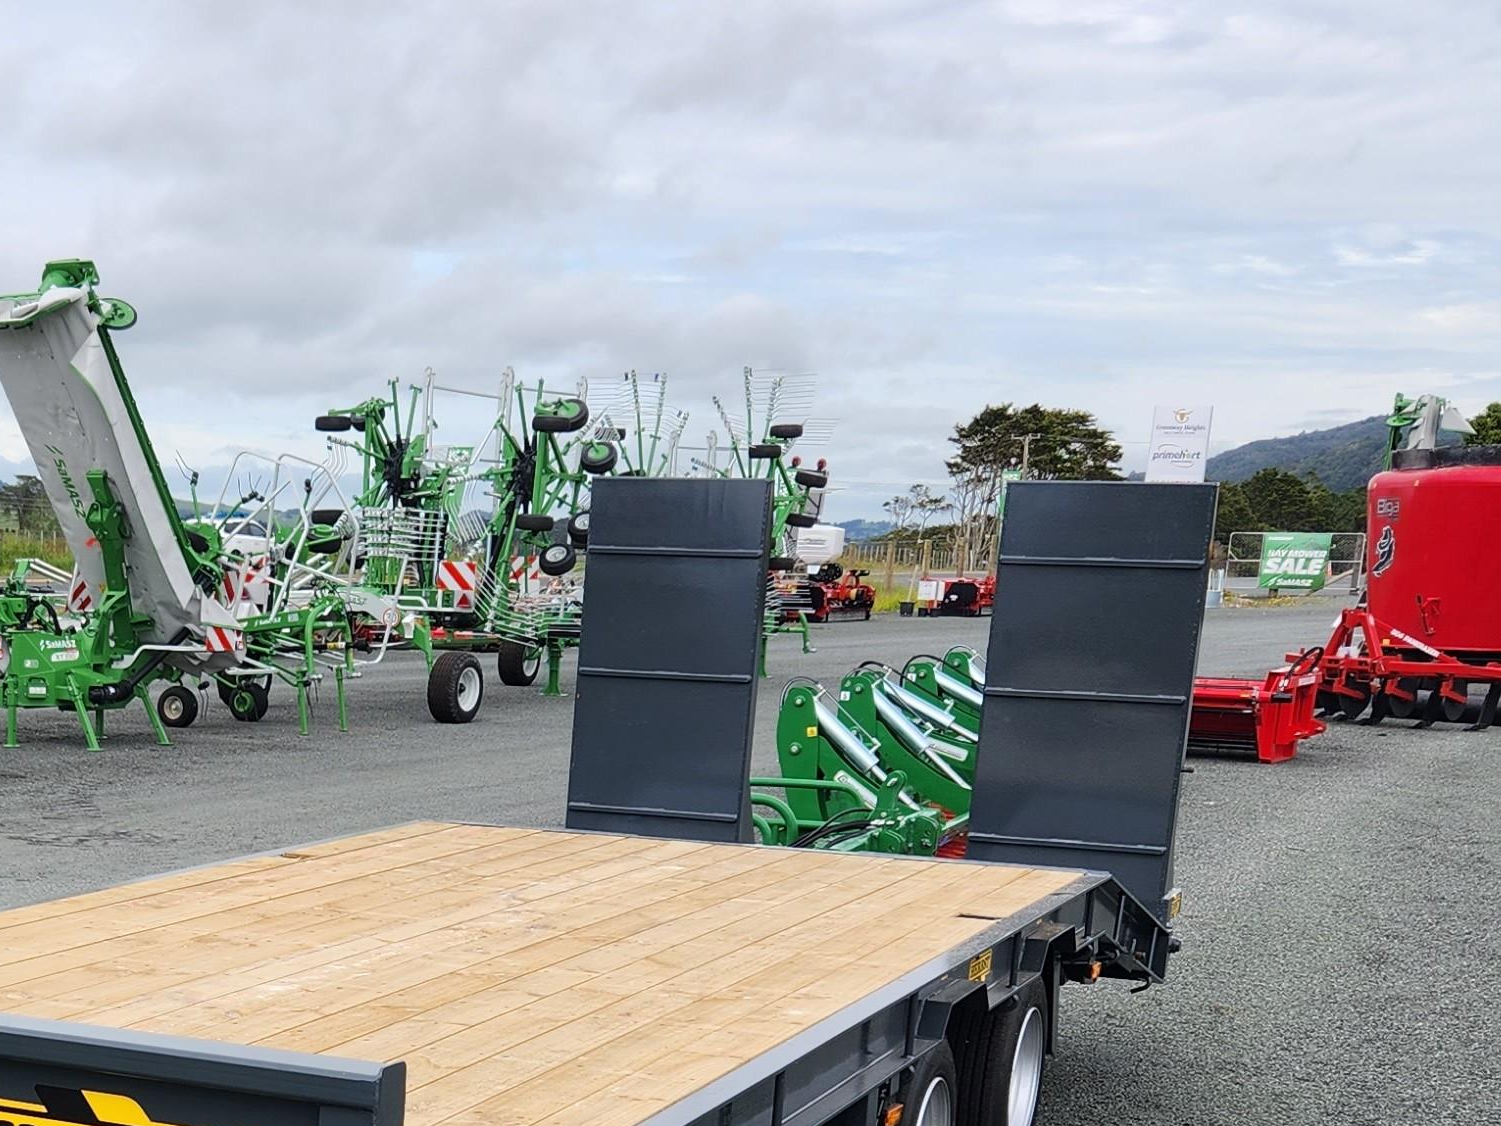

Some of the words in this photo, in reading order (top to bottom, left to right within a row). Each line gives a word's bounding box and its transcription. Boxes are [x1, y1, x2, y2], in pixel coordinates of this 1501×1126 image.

[53, 458, 87, 518] SaMASZ
[1287, 549, 1328, 559] MOWER
[1262, 557, 1325, 575] SALE
[45, 639, 77, 649] SaMASZ
